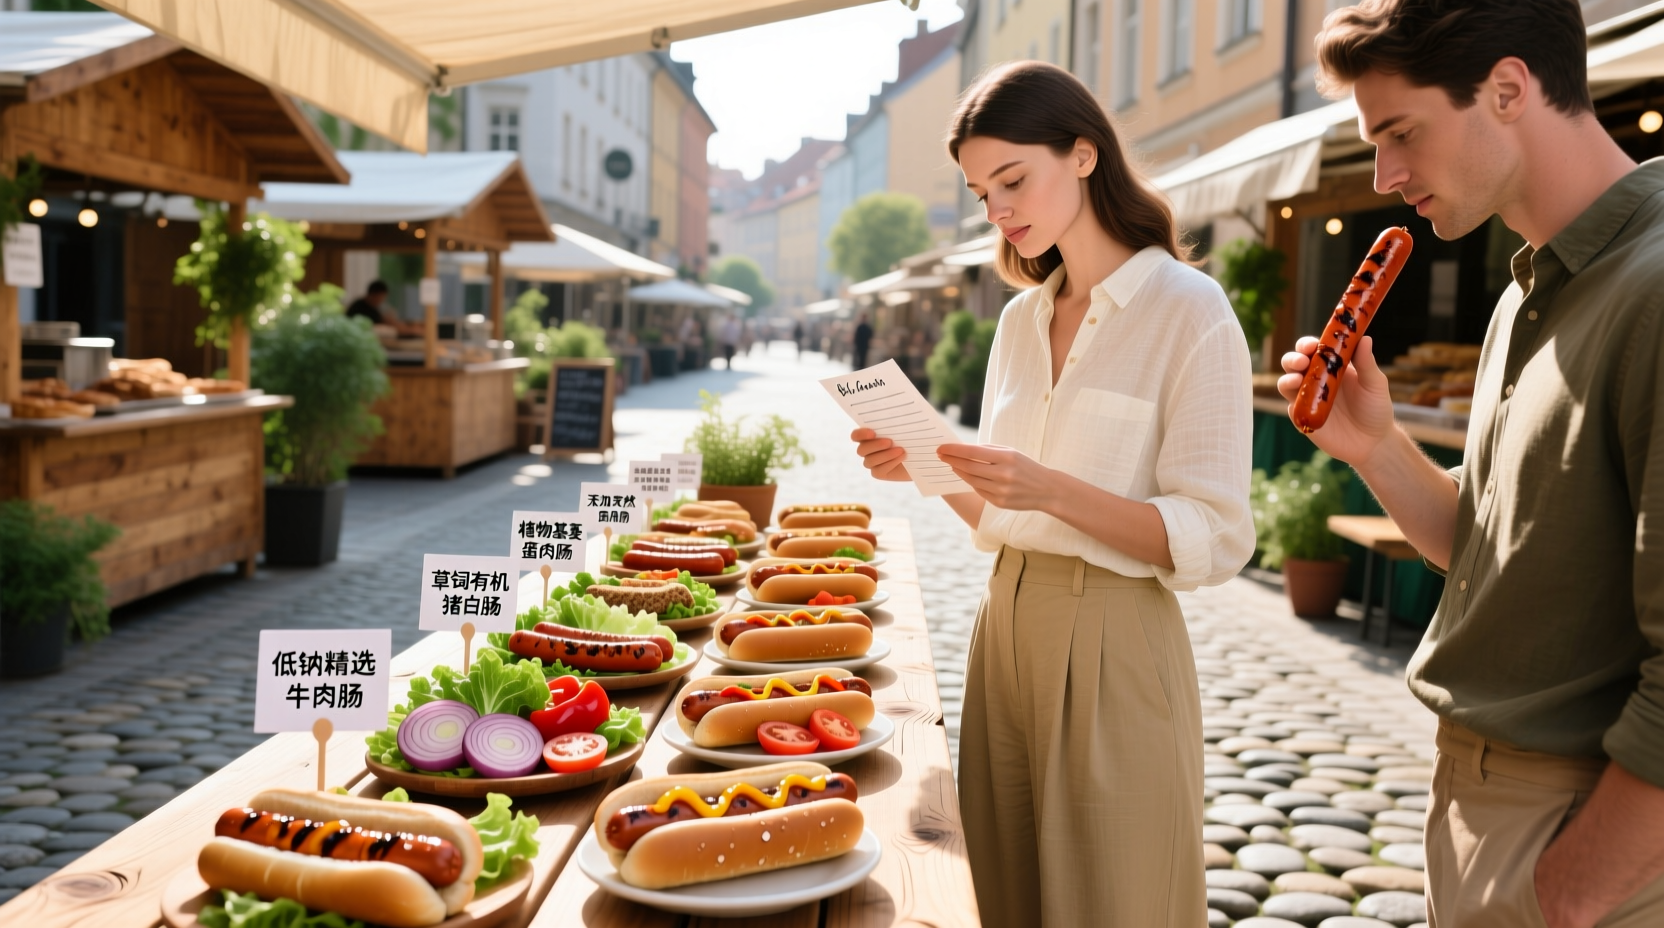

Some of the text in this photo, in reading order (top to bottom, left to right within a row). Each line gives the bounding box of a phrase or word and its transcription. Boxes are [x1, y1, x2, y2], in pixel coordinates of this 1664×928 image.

[442, 594, 501, 616] 猪白肠
[272, 649, 376, 676] 低钠精选
[285, 683, 363, 709] 牛肉肠
